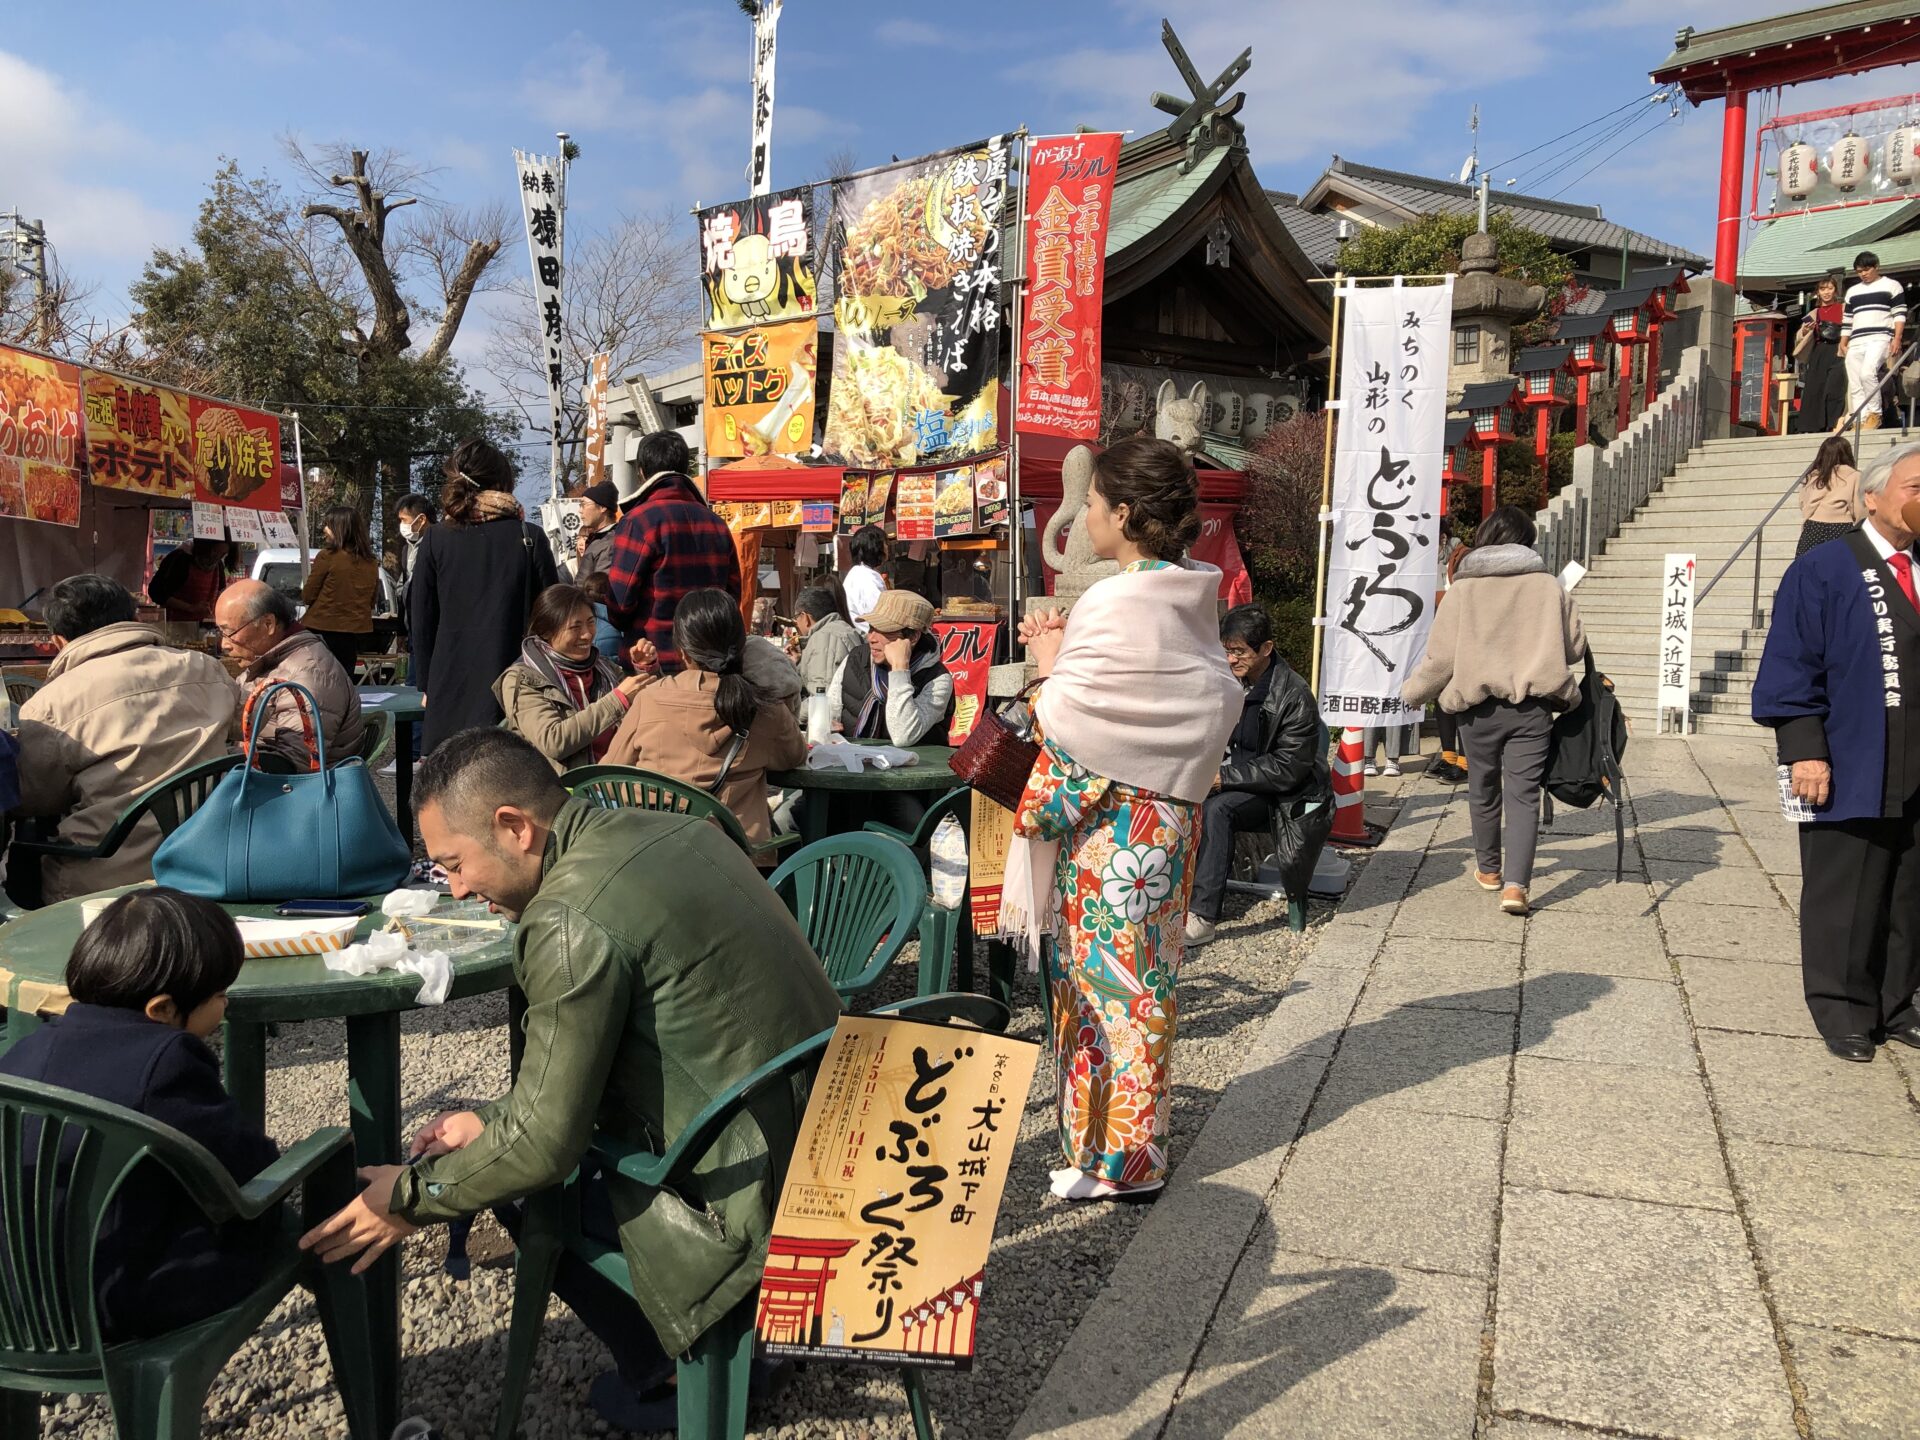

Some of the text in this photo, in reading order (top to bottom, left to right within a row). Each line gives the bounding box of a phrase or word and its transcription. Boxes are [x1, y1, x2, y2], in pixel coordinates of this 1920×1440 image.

[1034, 142, 1086, 167] からあげ
[1057, 155, 1113, 182] ナックル
[1788, 149, 1800, 189] 三光稲荷神社
[1841, 141, 1856, 178] 三光稲荷神社
[944, 155, 981, 374] 鉄板焼きそば
[970, 134, 1008, 334] 屋台の本格
[1074, 183, 1101, 297] 三年連続
[1027, 184, 1076, 389] 金賞受賞
[710, 332, 769, 371] チーズ
[713, 368, 788, 407] ハットグ
[1400, 311, 1421, 410] みちのく
[1016, 411, 1097, 431] からあげグランプリ
[1365, 359, 1391, 435] 山形の
[94, 441, 191, 488] ポテト
[194, 425, 275, 479] たい焼き
[1339, 444, 1431, 673] どぶろく
[1663, 566, 1688, 689] 犬山城へ近道
[1861, 568, 1902, 708] まつり実行委員会
[950, 1052, 1010, 1226] 第8回 犬山城下町
[851, 1045, 975, 1344] どぶろく祭り
